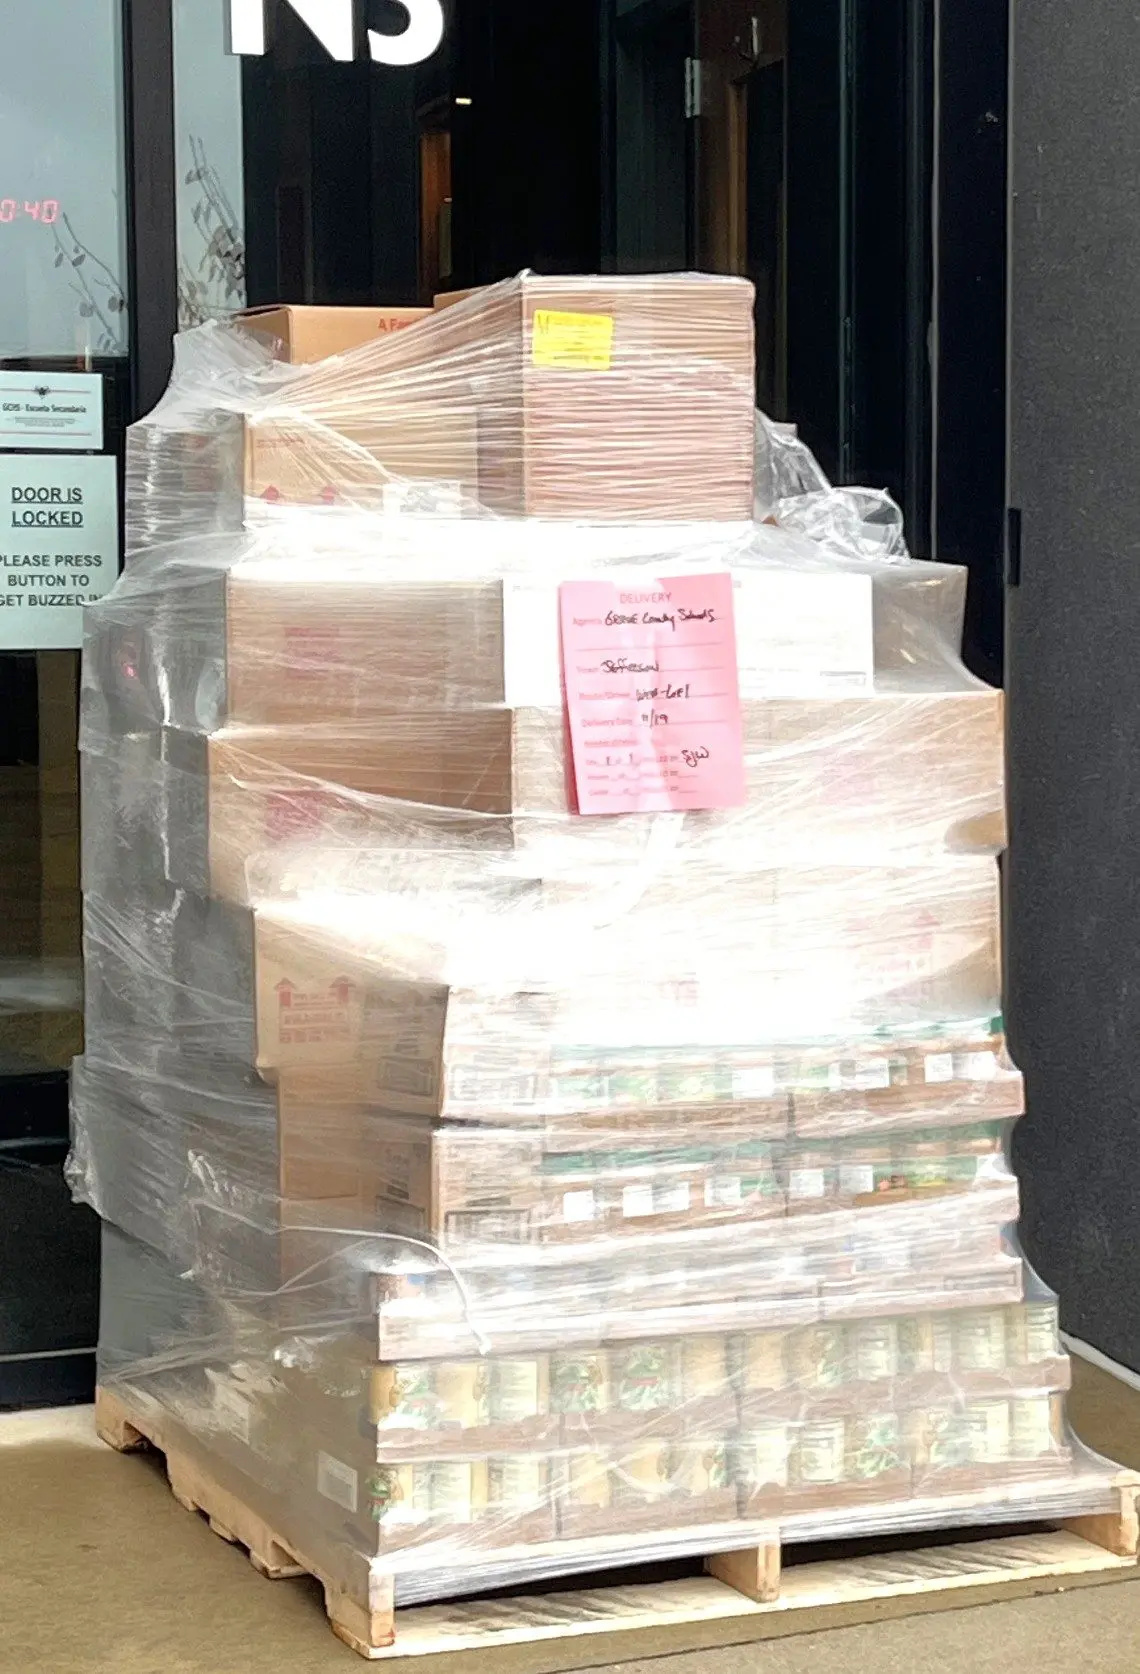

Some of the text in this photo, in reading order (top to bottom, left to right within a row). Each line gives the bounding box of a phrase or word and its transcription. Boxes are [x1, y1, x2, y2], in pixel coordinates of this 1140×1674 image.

[12, 487, 82, 503] DOOR IS
[12, 510, 83, 526] LOCKED
[0, 555, 102, 567] LEASE PRESS
[8, 574, 89, 587] BUTTON TO
[28, 595, 85, 606] BUZZED
[620, 592, 672, 604] DELIVERY
